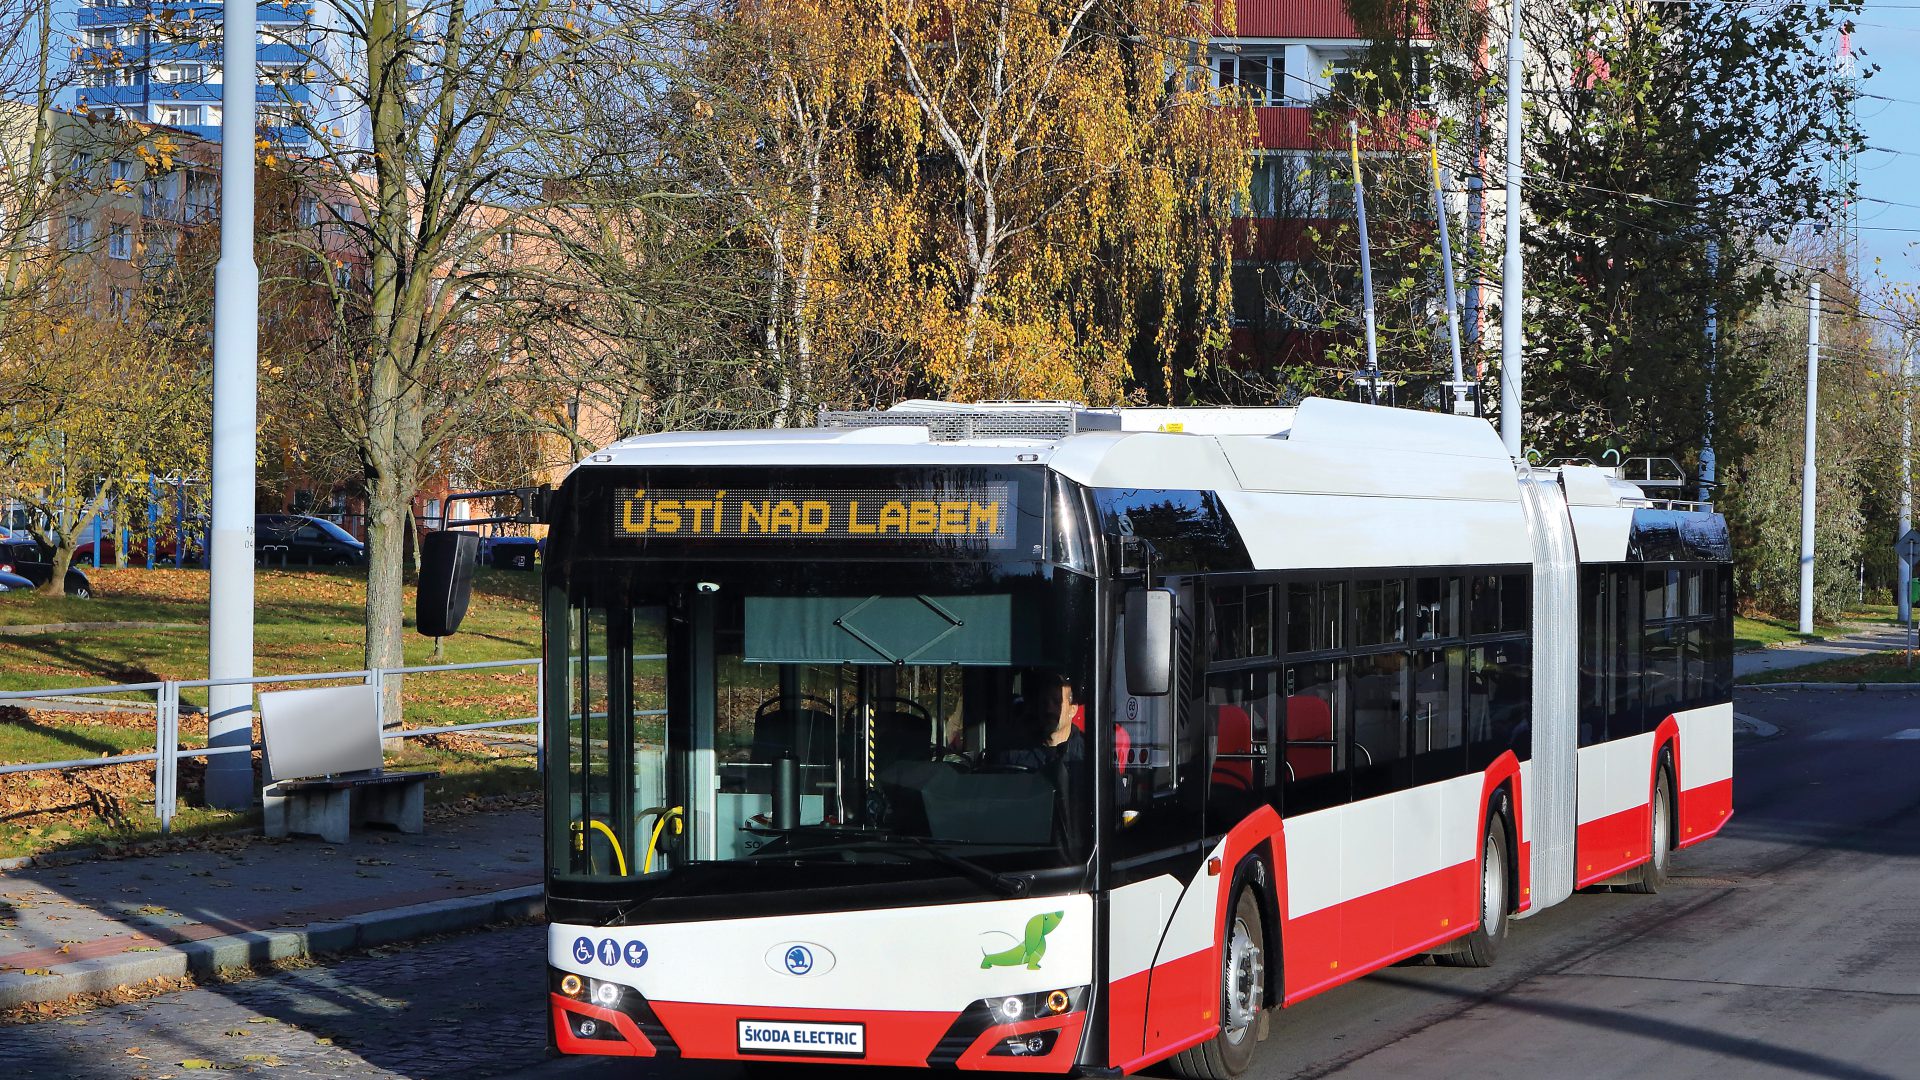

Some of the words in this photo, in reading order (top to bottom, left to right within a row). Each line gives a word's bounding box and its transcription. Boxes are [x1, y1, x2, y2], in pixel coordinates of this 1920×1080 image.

[623, 489, 726, 533] ÚSTÍ
[740, 500, 831, 533] NAD
[848, 501, 999, 533] LABEM
[745, 1026, 790, 1043] ŠKODA
[794, 1031, 857, 1046] ELECTRIC
